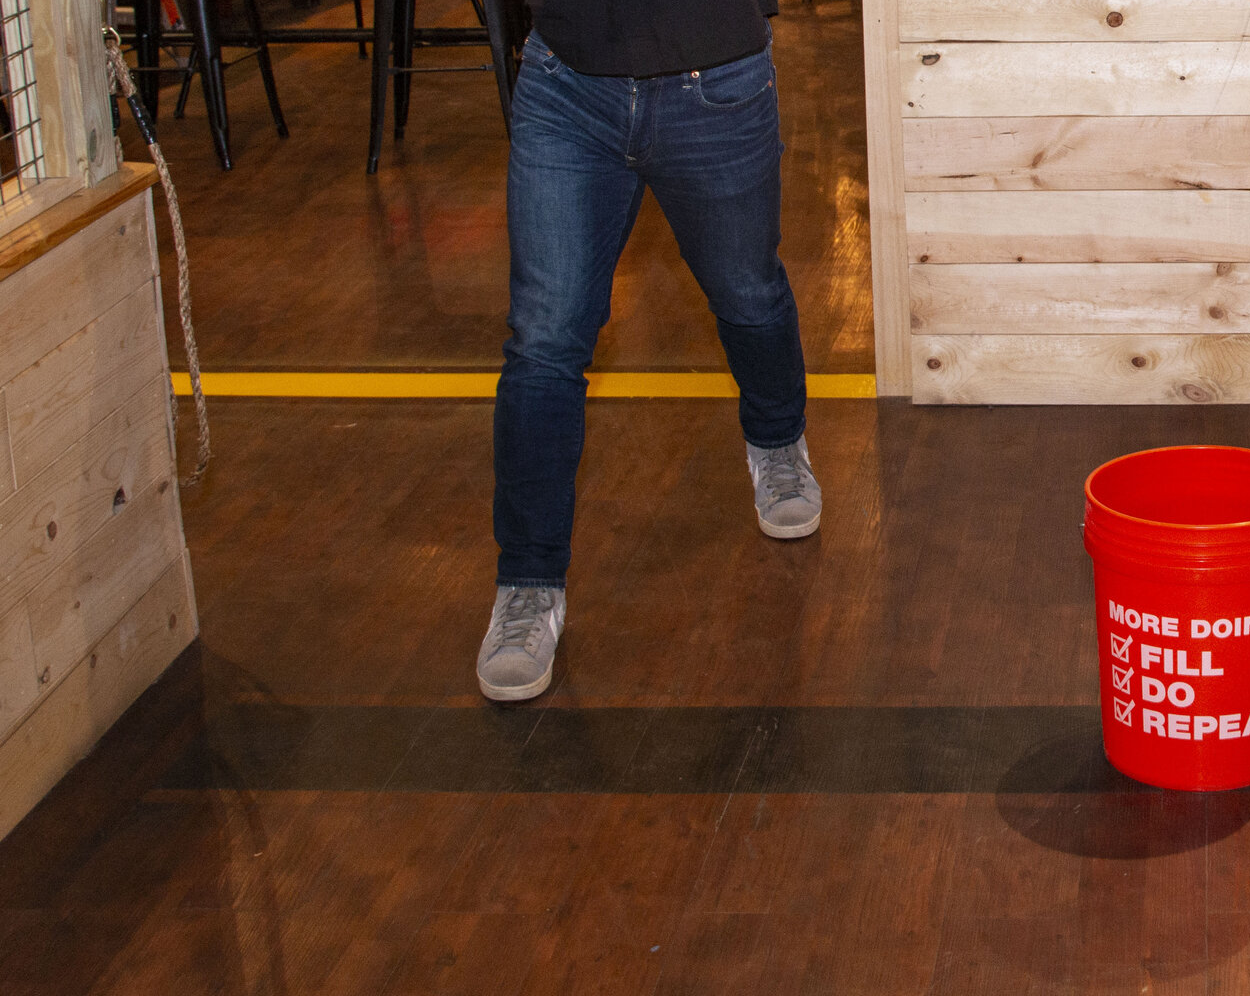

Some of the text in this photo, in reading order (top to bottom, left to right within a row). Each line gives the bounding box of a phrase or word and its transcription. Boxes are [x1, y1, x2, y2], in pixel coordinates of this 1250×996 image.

[1108, 600, 1180, 638] MORE
[1140, 643, 1224, 677] FILL
[1141, 675, 1195, 708] DO
